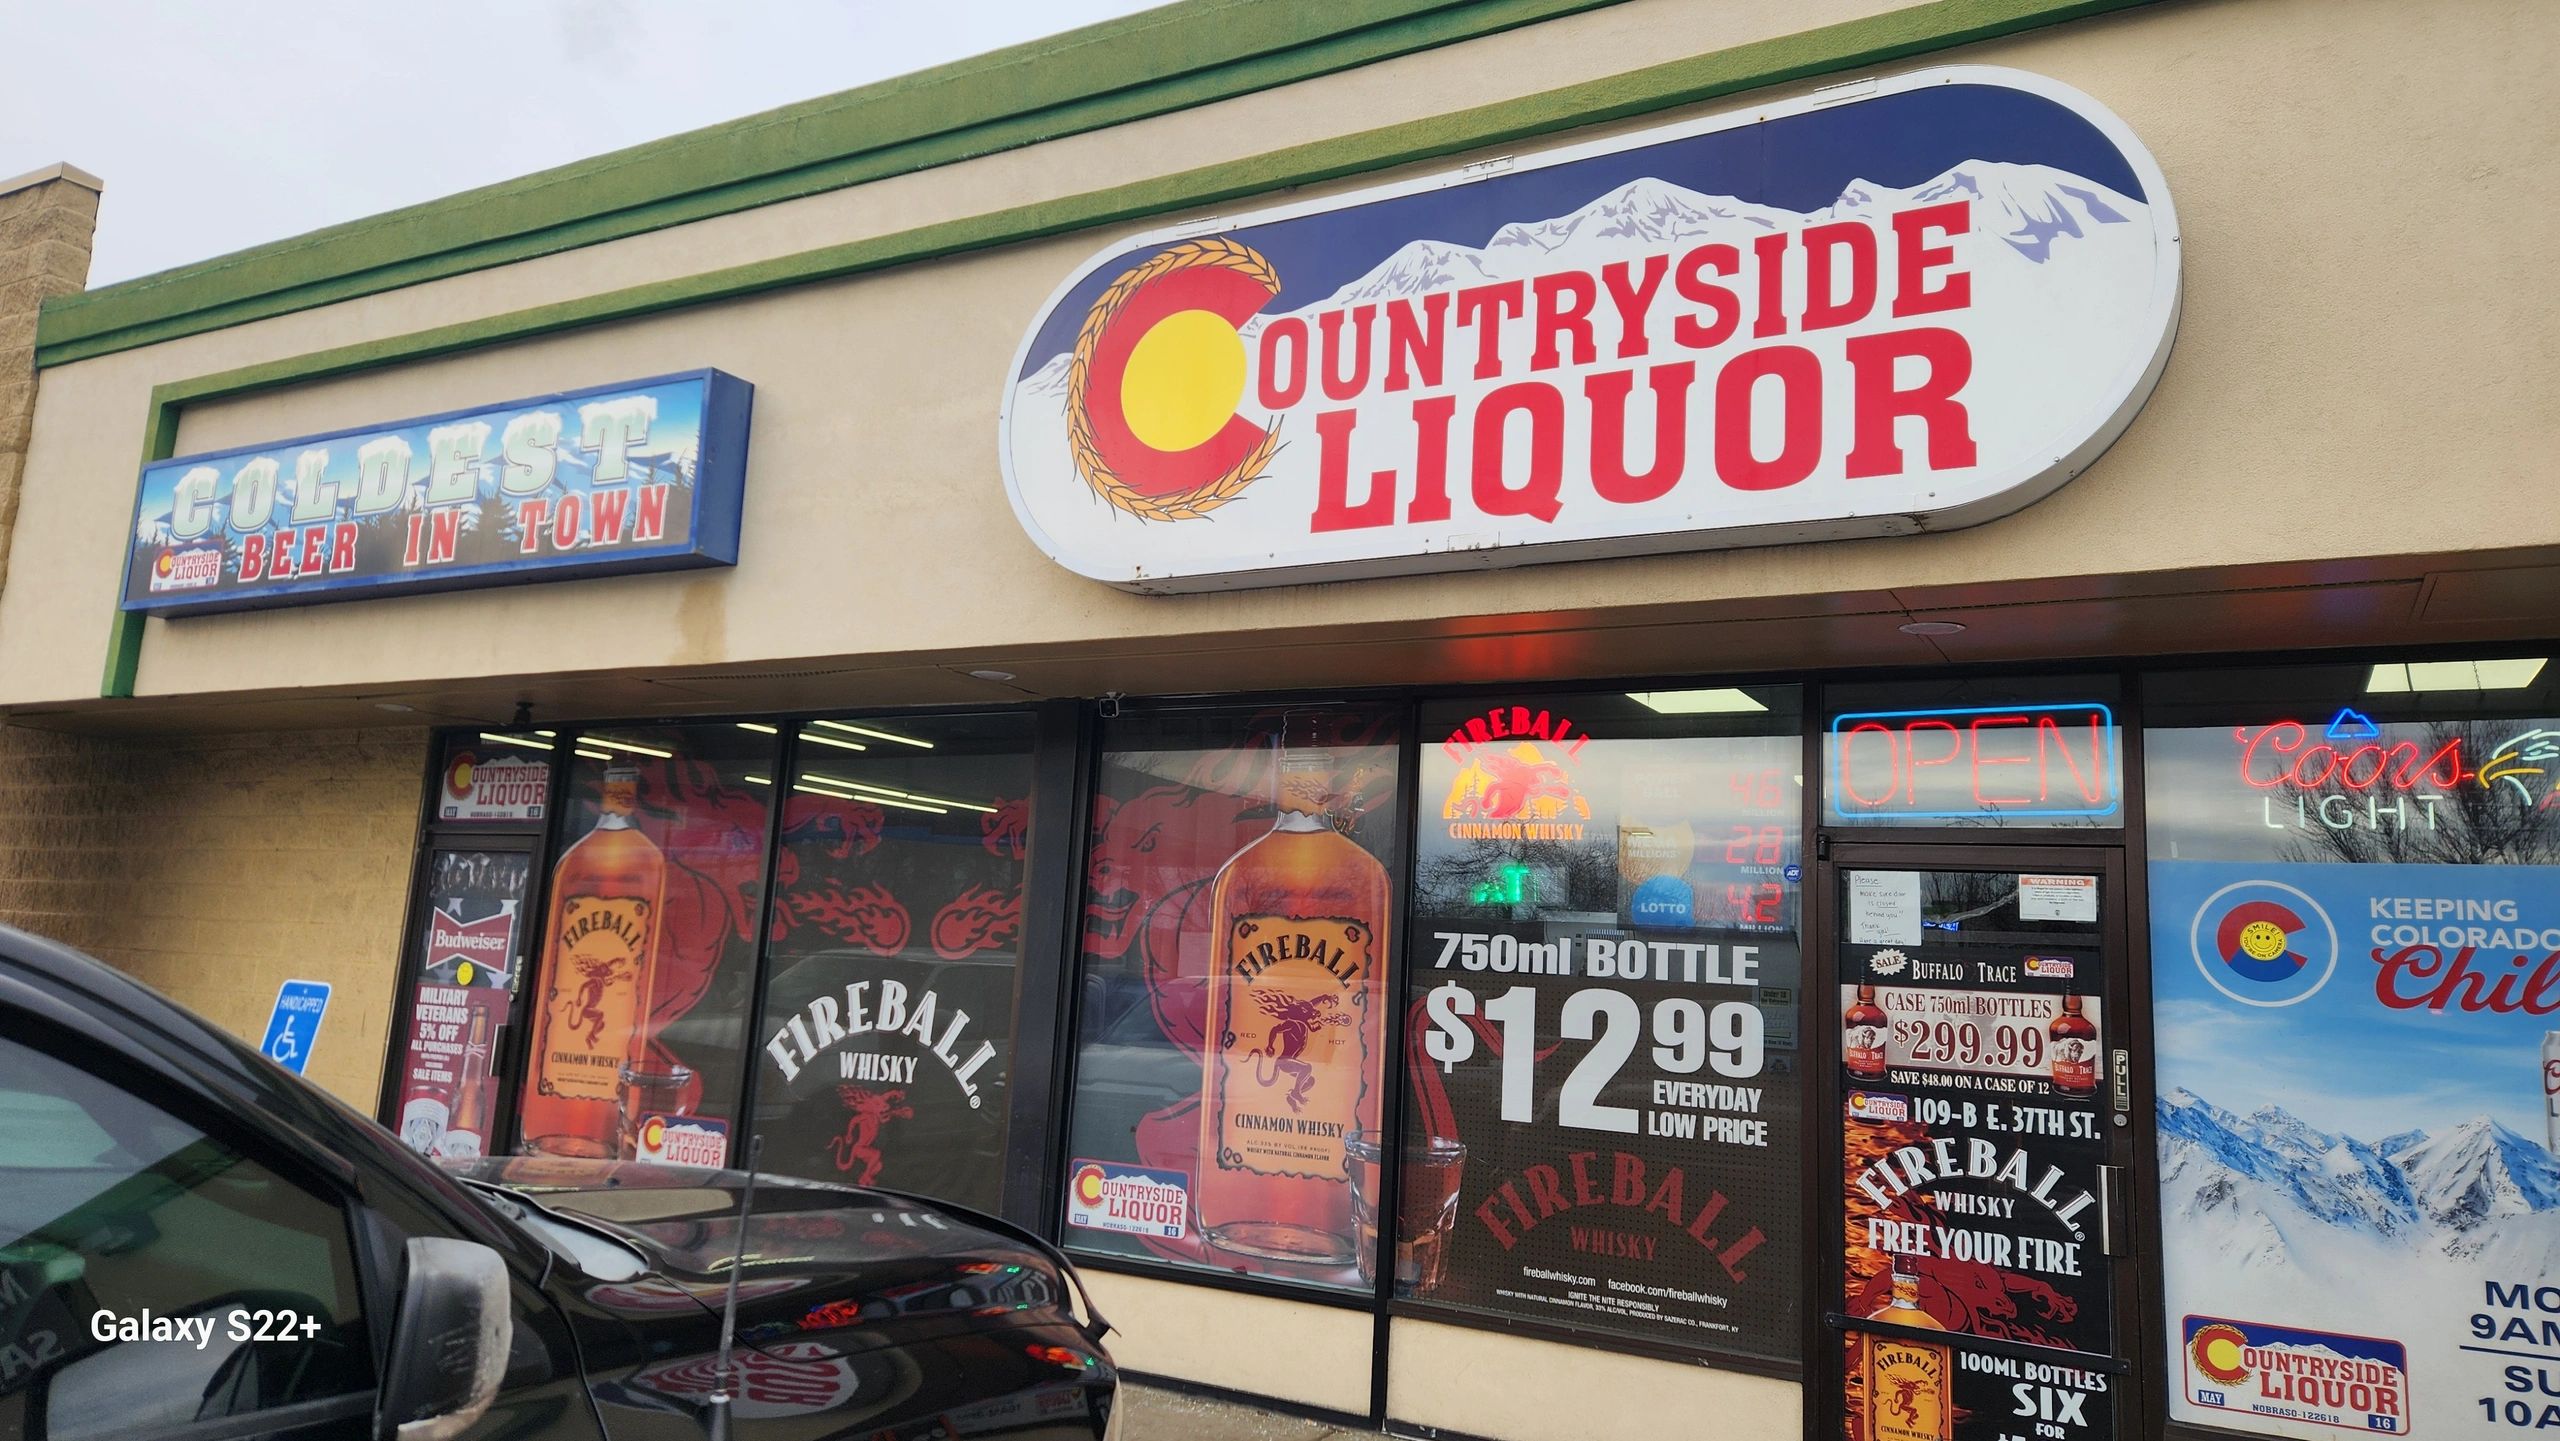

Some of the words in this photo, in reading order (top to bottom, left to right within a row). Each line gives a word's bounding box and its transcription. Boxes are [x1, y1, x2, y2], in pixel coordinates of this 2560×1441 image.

[1311, 326, 1977, 534] LIQUOR
[171, 394, 658, 539] COLDEST
[238, 522, 358, 584] BEER
[403, 508, 462, 566] IN
[518, 484, 667, 554] TOWN
[174, 564, 217, 580] LIQUOR
[1441, 706, 1590, 766] FIREBALL
[1842, 714, 2101, 805] OPEN
[2233, 721, 2475, 789] Coors
[476, 783, 545, 806] LIQUOR
[1728, 768, 1783, 808] 46
[2264, 795, 2444, 830] LIGHT
[1448, 823, 1521, 841] CINNAMON
[1526, 824, 1584, 841] WHISKY
[1725, 824, 1785, 865] 28
[1740, 866, 1784, 875] MILLION
[1854, 875, 1880, 885] Please
[2030, 878, 2085, 886] WARNING
[1640, 903, 1686, 914] LOTTO
[1740, 924, 1783, 934] MILLION
[2370, 897, 2518, 922] KEEPING
[434, 928, 505, 951] Budweiser
[562, 910, 641, 952] FIREBALL
[2371, 924, 2560, 951] COLORADO
[1235, 933, 1360, 990] FIREBALL
[1433, 932, 1571, 976] 750ml
[1587, 938, 1759, 986] BOTTLE
[1875, 954, 1902, 969] SALE
[2041, 966, 2072, 974] LIQUOR
[279, 995, 323, 1013] HANDICAPPED
[419, 986, 469, 1007] MILITARY
[1885, 991, 1926, 1012] CASE
[1930, 995, 1971, 1015] 750ml
[1976, 996, 2052, 1019] BOTTLES
[415, 1003, 468, 1025] VETERANS
[410, 1039, 423, 1051] ALL
[423, 1040, 464, 1055] PURCHASES
[419, 1023, 436, 1040] 5%
[438, 1024, 459, 1042] OFF
[1894, 1018, 2045, 1069] $299.99
[412, 1067, 431, 1081] SALE
[431, 1070, 453, 1083] ITEMS
[839, 1051, 918, 1084] WHISKY
[1890, 1069, 1920, 1086] SAVE
[1921, 1072, 1953, 1088] $48.00
[1955, 1075, 1972, 1089] ON
[1973, 1077, 1982, 1090] A
[1983, 1077, 2016, 1093] CASE
[2018, 1080, 2035, 1094] OF
[2038, 1082, 2049, 1095] 12
[2116, 1054, 2126, 1096] PULL
[1653, 1079, 1762, 1113] EVERYDAY
[1235, 1113, 1294, 1134] CINNAMON
[1297, 1119, 1345, 1139] WHISKY
[1869, 1106, 1905, 1117] LIQUOR
[1913, 1097, 1978, 1128] 109-B
[1986, 1104, 2008, 1132] E.
[2011, 1105, 2065, 1138] 37TH
[2069, 1111, 2101, 1140] ST.
[1648, 1110, 1699, 1140] LOW
[1702, 1118, 1768, 1147] PRICE
[666, 1144, 721, 1167] LIQUOR
[1108, 1197, 1182, 1226] LIQUOR
[1475, 1151, 1768, 1284] FIREBALL
[1933, 1190, 2015, 1219] WHISKY
[1570, 1226, 1657, 1261] WHISKY
[1867, 1217, 1933, 1257] FREE
[1935, 1226, 2012, 1268] YOUR
[2017, 1236, 2082, 1277] FIRE
[1523, 1266, 1596, 1287] fireballwhisky.com
[1608, 1278, 1728, 1309] facebook.com/fireballwhisky
[1568, 1291, 1588, 1302] IGNITE
[1588, 1294, 1600, 1304] THE
[1602, 1296, 1615, 1305] NITE
[1616, 1298, 1660, 1312] RESPONSIBLY
[1629, 1310, 1656, 1321] PRODUCED
[1656, 1313, 1664, 1321] BY
[1731, 1325, 1739, 1333] KY
[1875, 1351, 1939, 1380] FIREBALL
[1960, 1351, 2021, 1379] 100ML
[2024, 1361, 2109, 1393] BOTTLES
[2012, 1382, 2089, 1428] SIX
[2259, 1371, 2400, 1416] LIQUOR
[2200, 1391, 2223, 1405] MAY
[2375, 1416, 2391, 1430] 16
[2478, 1397, 2560, 1430] 10A
[1880, 1425, 1910, 1437] CINNAMON
[1911, 1430, 1935, 1441] WHISKY
[2035, 1422, 2065, 1440] FOR
